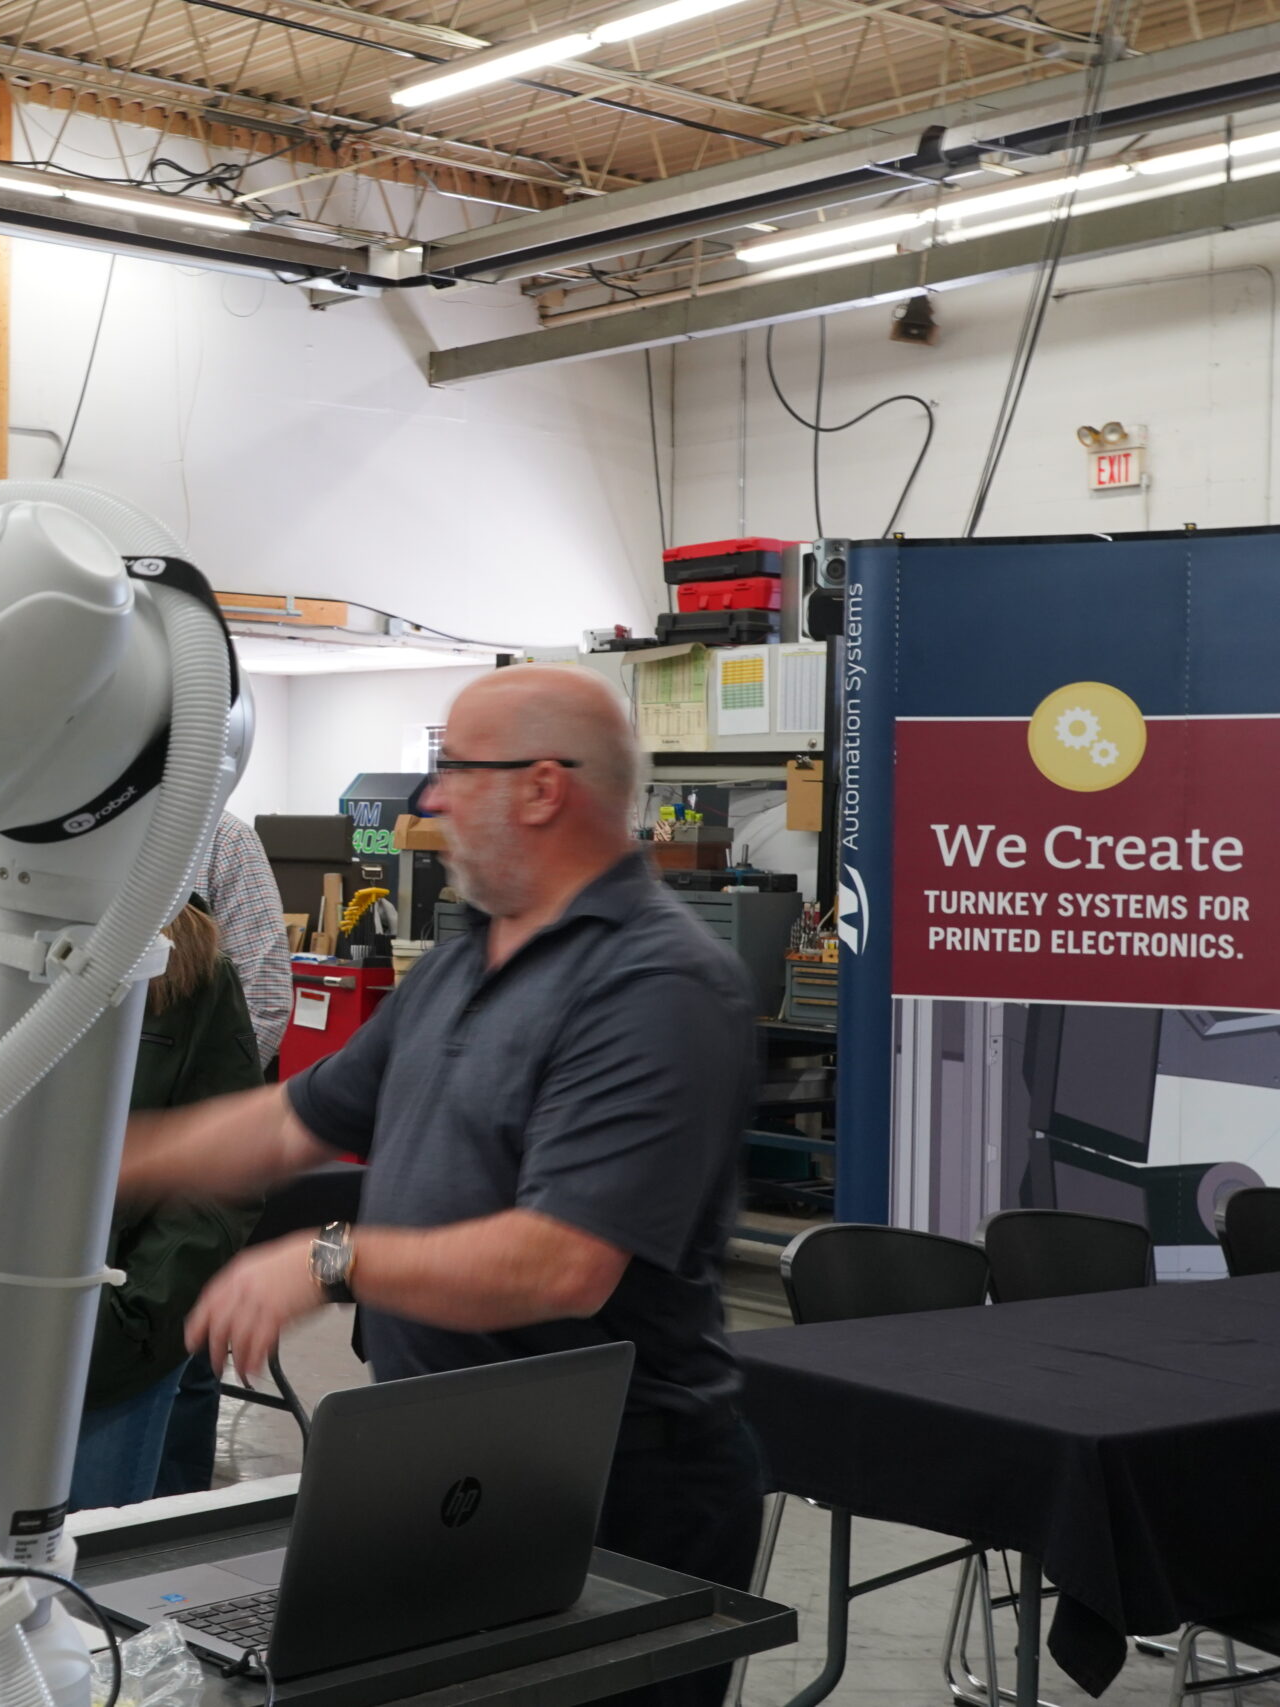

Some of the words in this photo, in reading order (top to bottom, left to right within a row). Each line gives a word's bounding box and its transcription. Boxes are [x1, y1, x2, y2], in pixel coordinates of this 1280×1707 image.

[1097, 453, 1132, 485] EXIT
[844, 582, 866, 691] Systems
[842, 699, 861, 850] Automation
[348, 802, 382, 827] VM
[930, 824, 1027, 868] We
[1044, 825, 1244, 872] Create
[924, 890, 1048, 916] TURNKEY
[1057, 893, 1188, 919] SYSTEMS
[1199, 895, 1250, 921] FOR
[929, 926, 1041, 952] PRINTED
[1051, 930, 1244, 960] ELECTRONICS.
